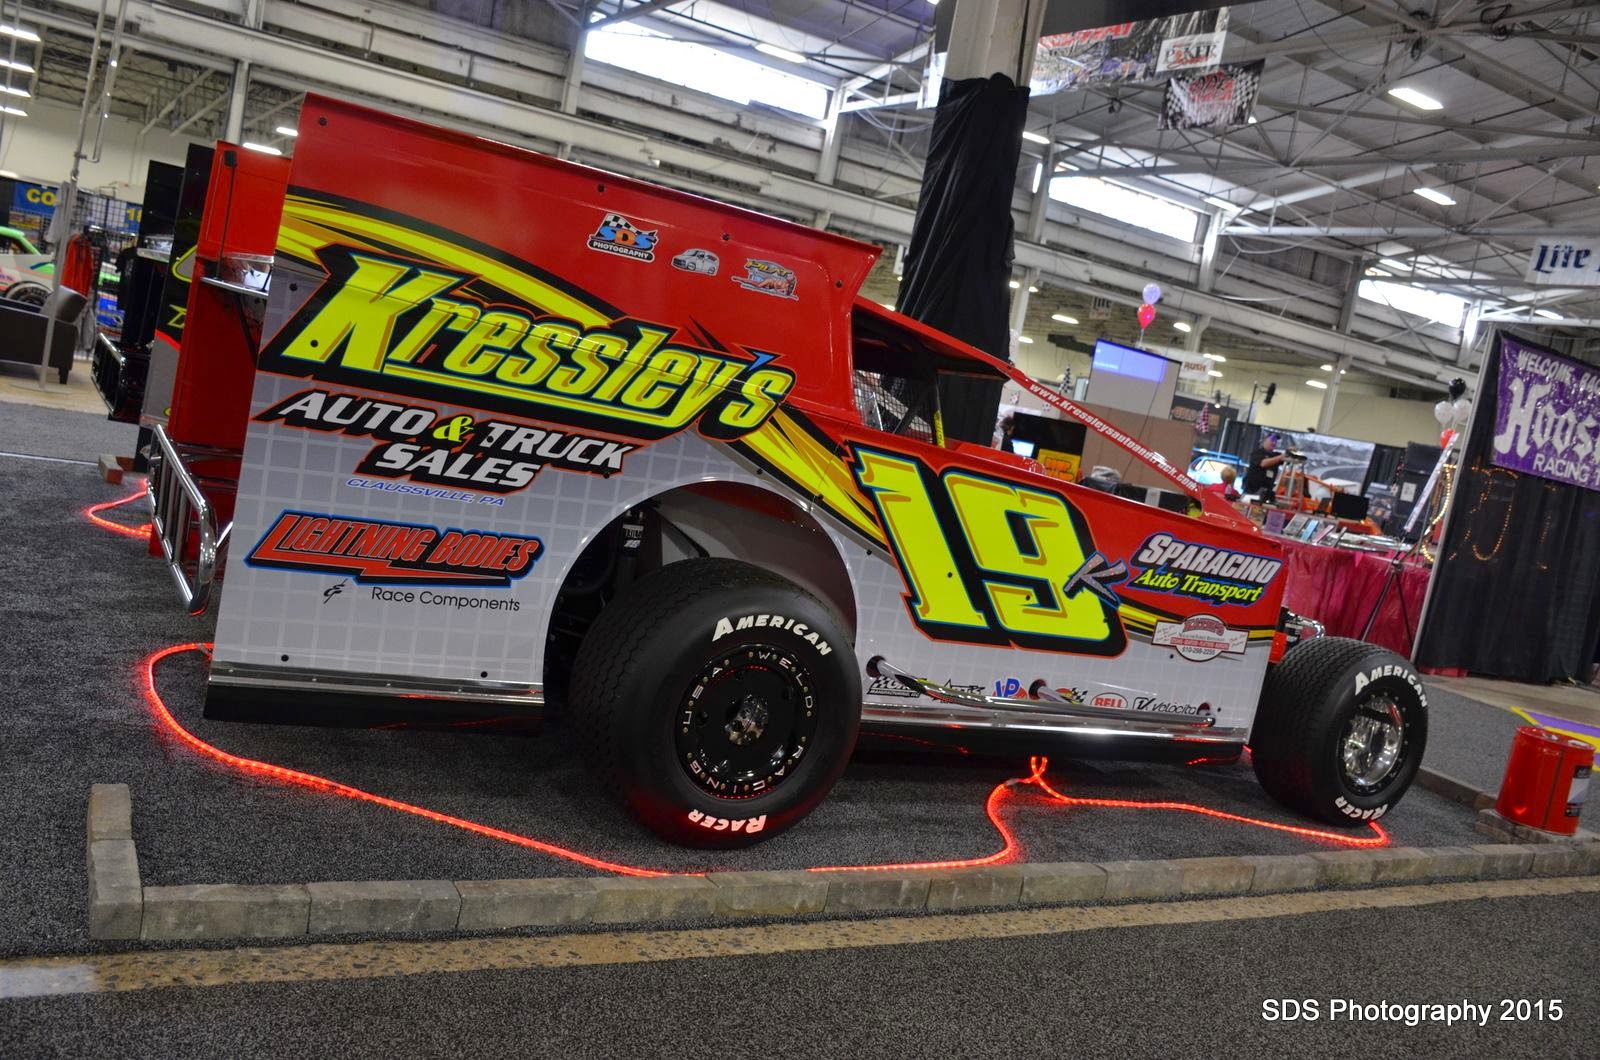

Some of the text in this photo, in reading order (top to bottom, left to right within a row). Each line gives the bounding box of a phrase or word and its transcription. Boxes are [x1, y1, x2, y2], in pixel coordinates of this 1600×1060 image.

[592, 241, 649, 259] PHOTOGRAPHY
[599, 226, 657, 249] SDS
[1533, 245, 1591, 274] Lite
[281, 254, 793, 428] Kressley's
[1184, 361, 1207, 372] RUSH
[1517, 349, 1575, 384] WELCOME
[279, 391, 634, 470] AUTO & TRUCK
[375, 443, 542, 488] SALES
[1532, 453, 1590, 483] RACING
[346, 478, 505, 506] CLAUSSVILLE, PA
[253, 514, 537, 571] LIGHTNING BODIES
[856, 448, 1110, 641] 19
[1138, 534, 1283, 584] SPARACINO
[371, 586, 520, 612] Race Components
[1134, 569, 1263, 602] Auto Transport
[711, 614, 832, 656] AMERICAN
[1354, 664, 1428, 708] AMERICAN
[687, 808, 767, 834] RACER
[1335, 795, 1389, 821] RACER
